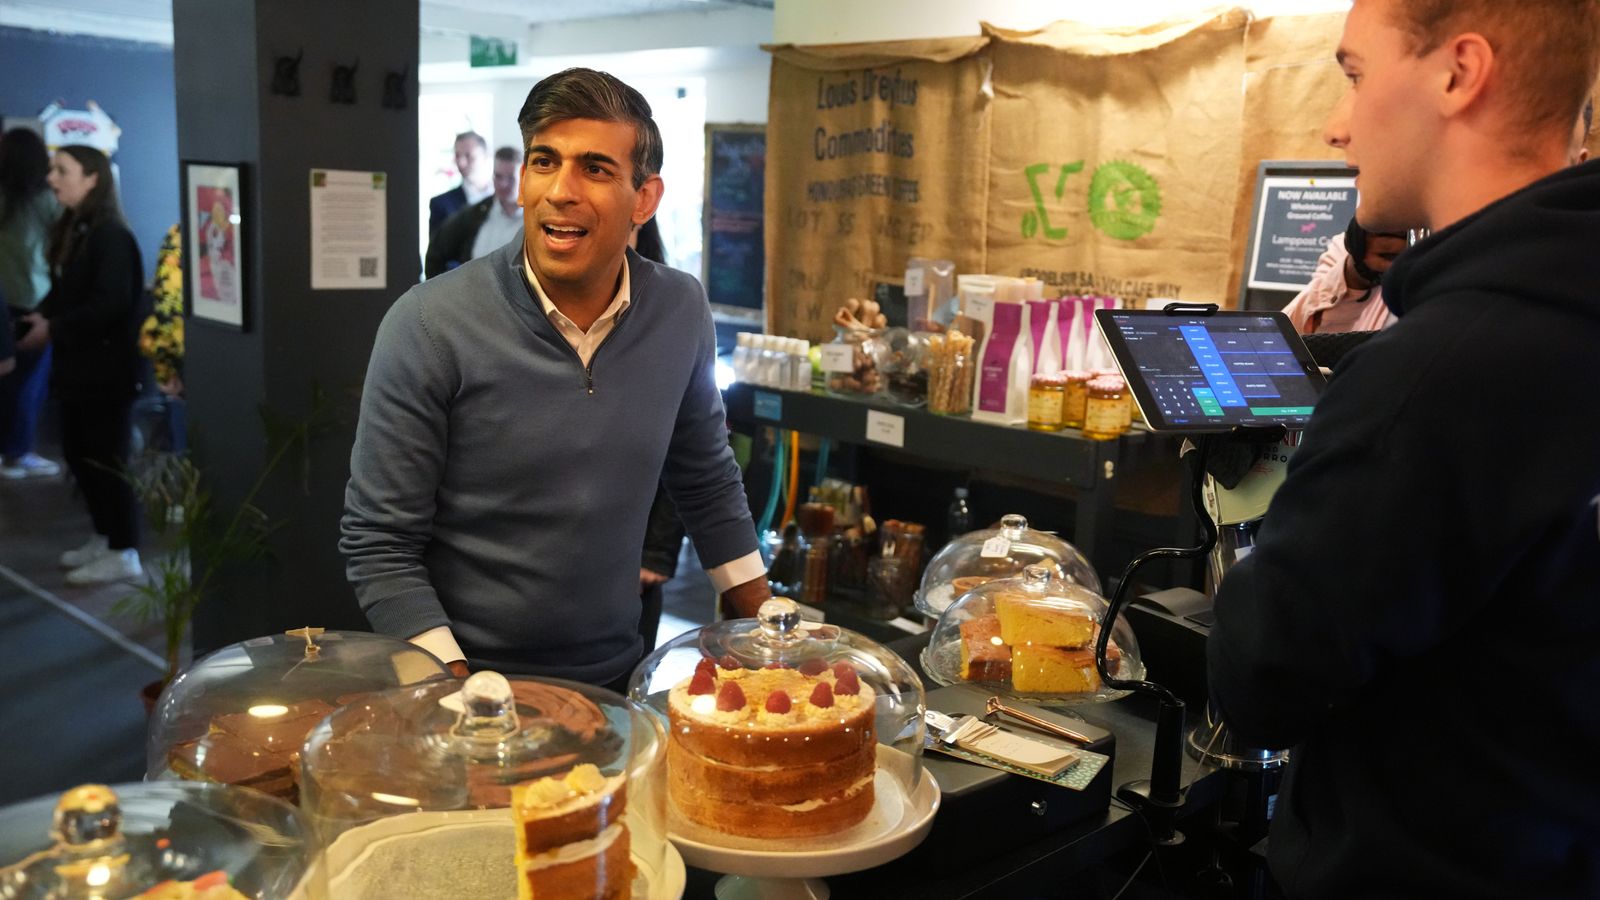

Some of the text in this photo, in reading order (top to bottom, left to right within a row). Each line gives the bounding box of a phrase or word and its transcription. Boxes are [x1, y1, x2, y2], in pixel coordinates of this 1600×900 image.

[817, 68, 918, 110] Louis Dreyfus
[1277, 190, 1348, 202] NOW AVAILABLE
[1286, 211, 1334, 221] Ground Coffee
[1271, 234, 1317, 248] Lamppost
